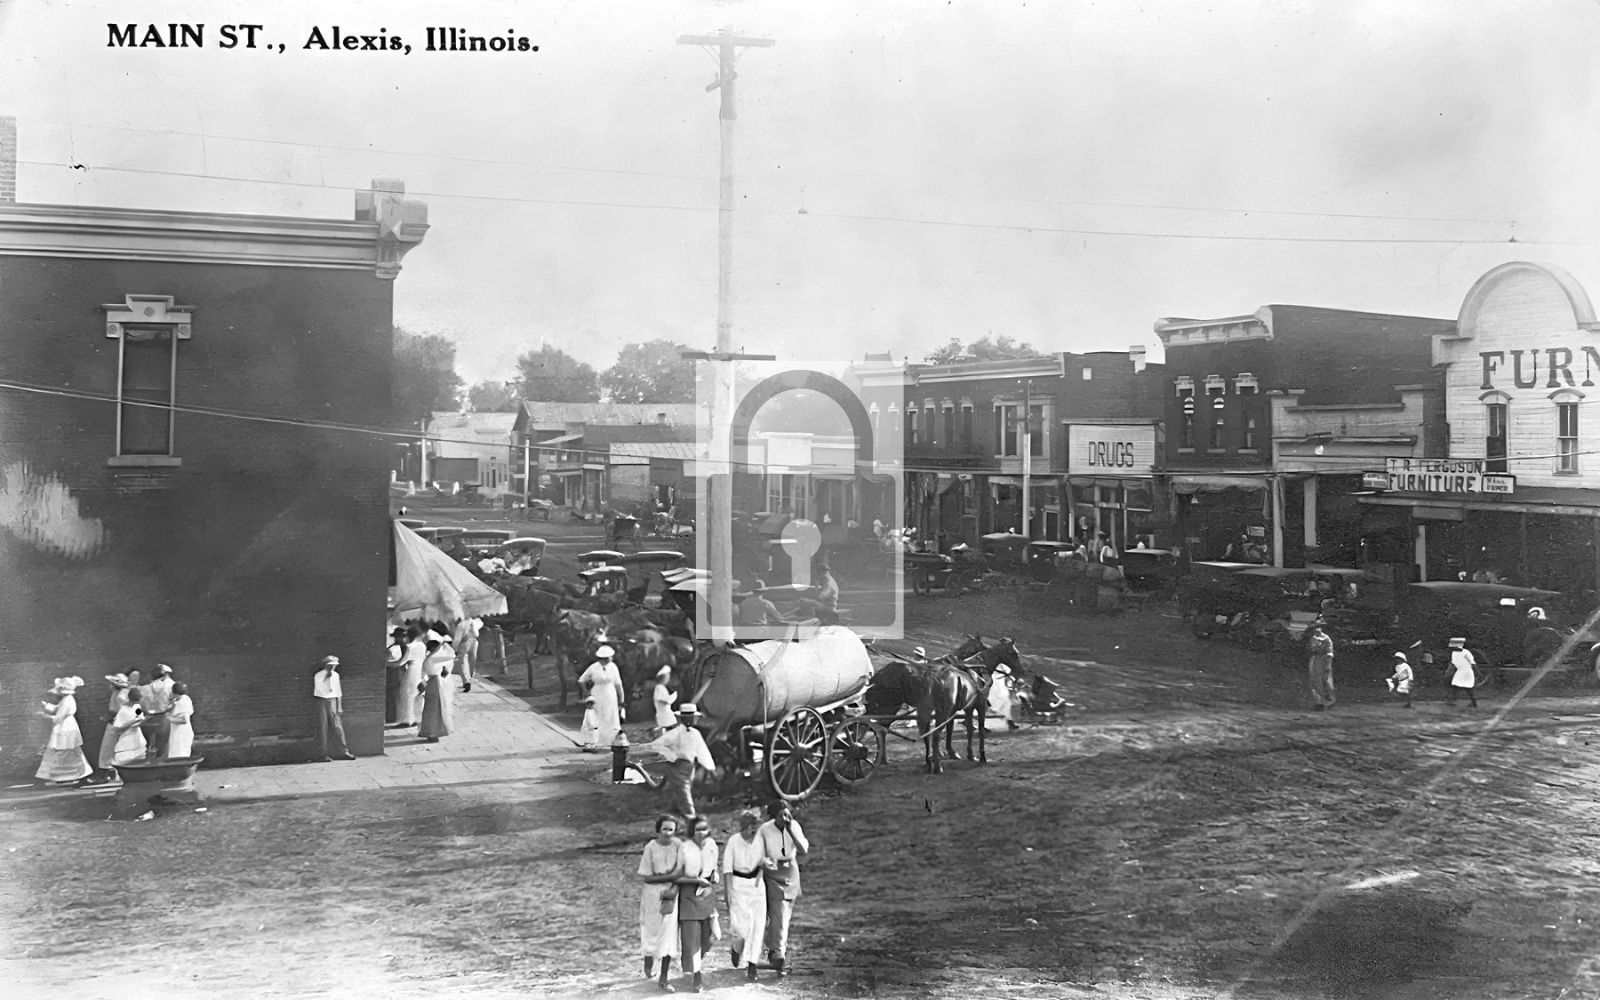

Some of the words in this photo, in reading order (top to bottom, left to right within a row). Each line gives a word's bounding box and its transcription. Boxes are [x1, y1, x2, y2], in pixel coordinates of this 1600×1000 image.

[1088, 441, 1135, 468] DRUGS
[1419, 460, 1483, 475] FERGUSON
[1389, 473, 1477, 493] FURNITURE
